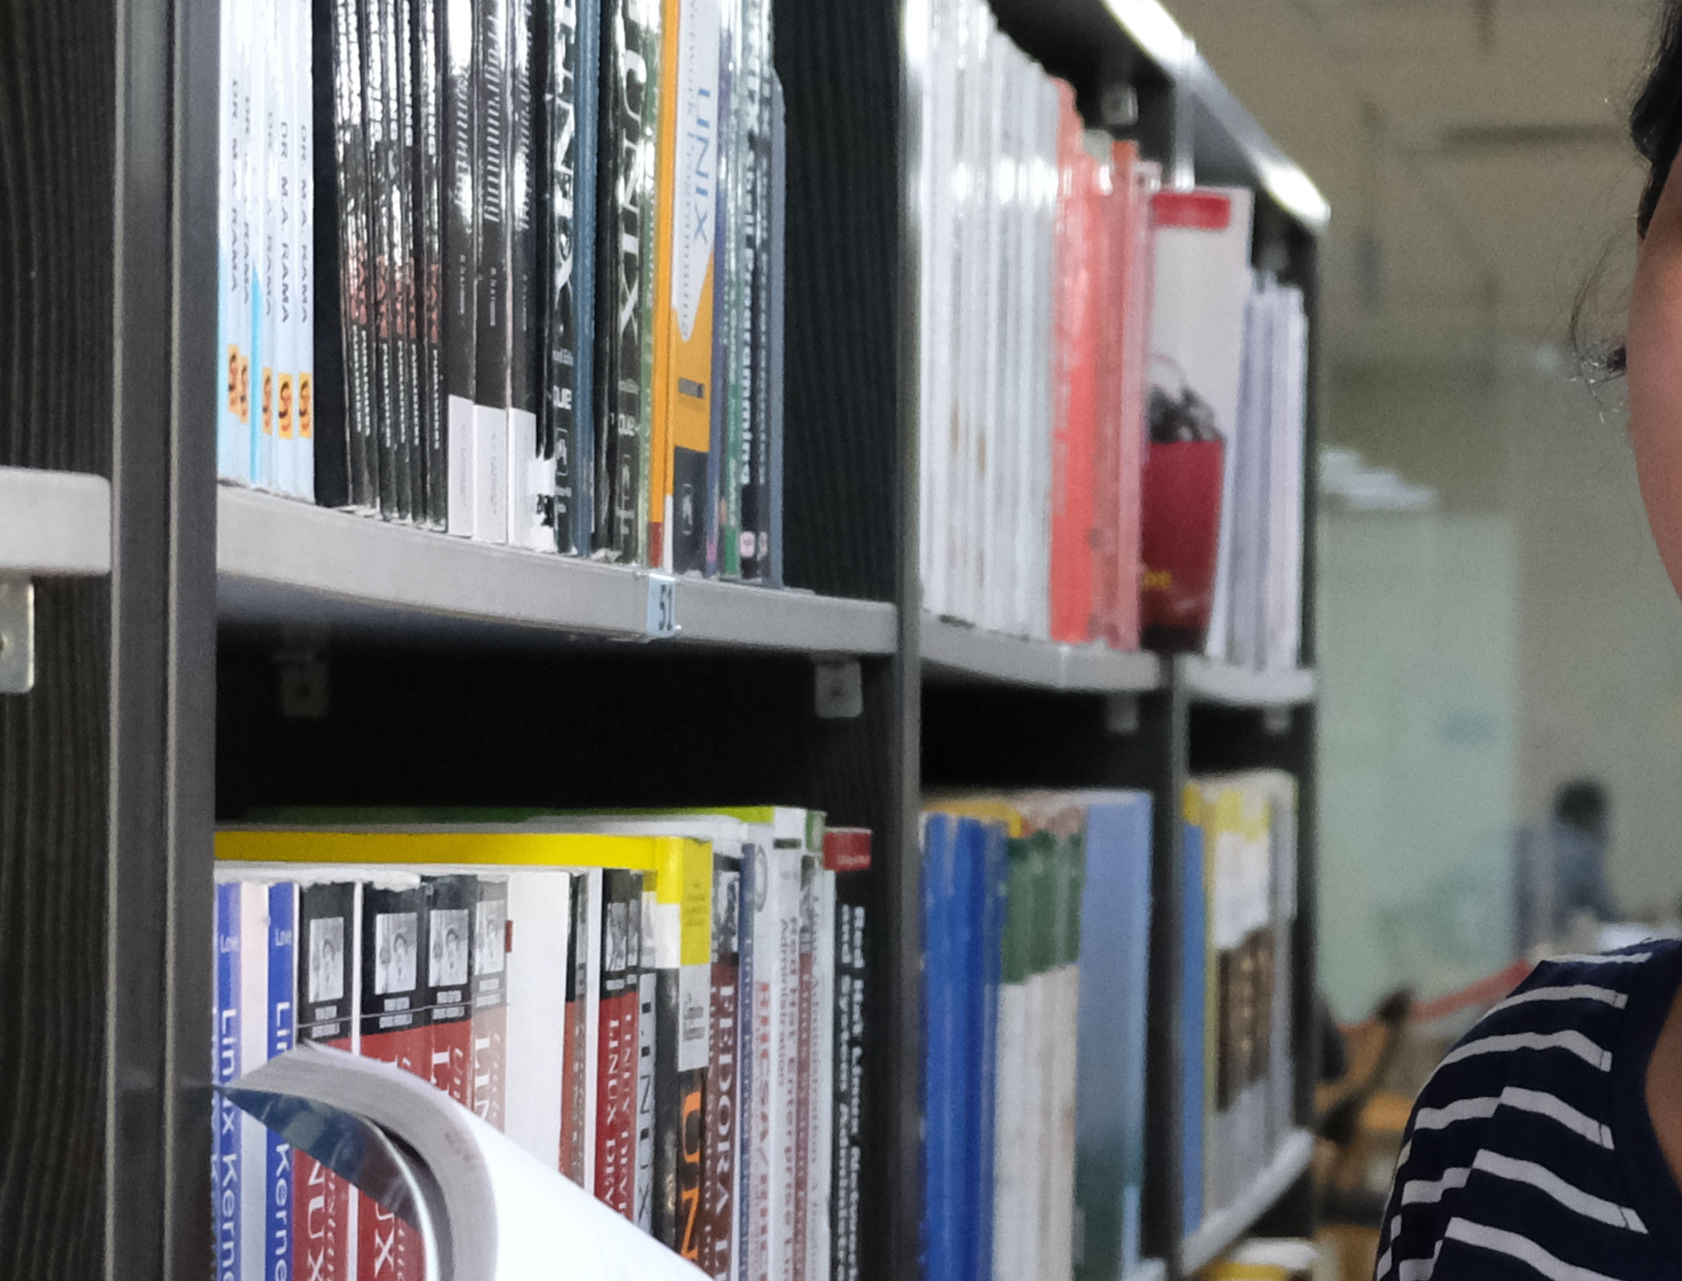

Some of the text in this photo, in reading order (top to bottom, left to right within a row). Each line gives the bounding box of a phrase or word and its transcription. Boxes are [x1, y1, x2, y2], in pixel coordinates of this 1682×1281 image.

[695, 88, 710, 244] UNIX
[744, 150, 755, 236] Shell
[789, 917, 797, 975] Red
[841, 905, 851, 964] and
[853, 906, 866, 968] Red
[778, 918, 788, 1086] Administration
[788, 987, 796, 1040] Hat
[840, 974, 851, 1092] System
[852, 979, 864, 1037] Hat
[607, 1019, 619, 1126] LINUX
[716, 985, 734, 1213] FEDORA
[851, 1045, 863, 1136] Linux
[783, 1057, 795, 1226] Enterprise
